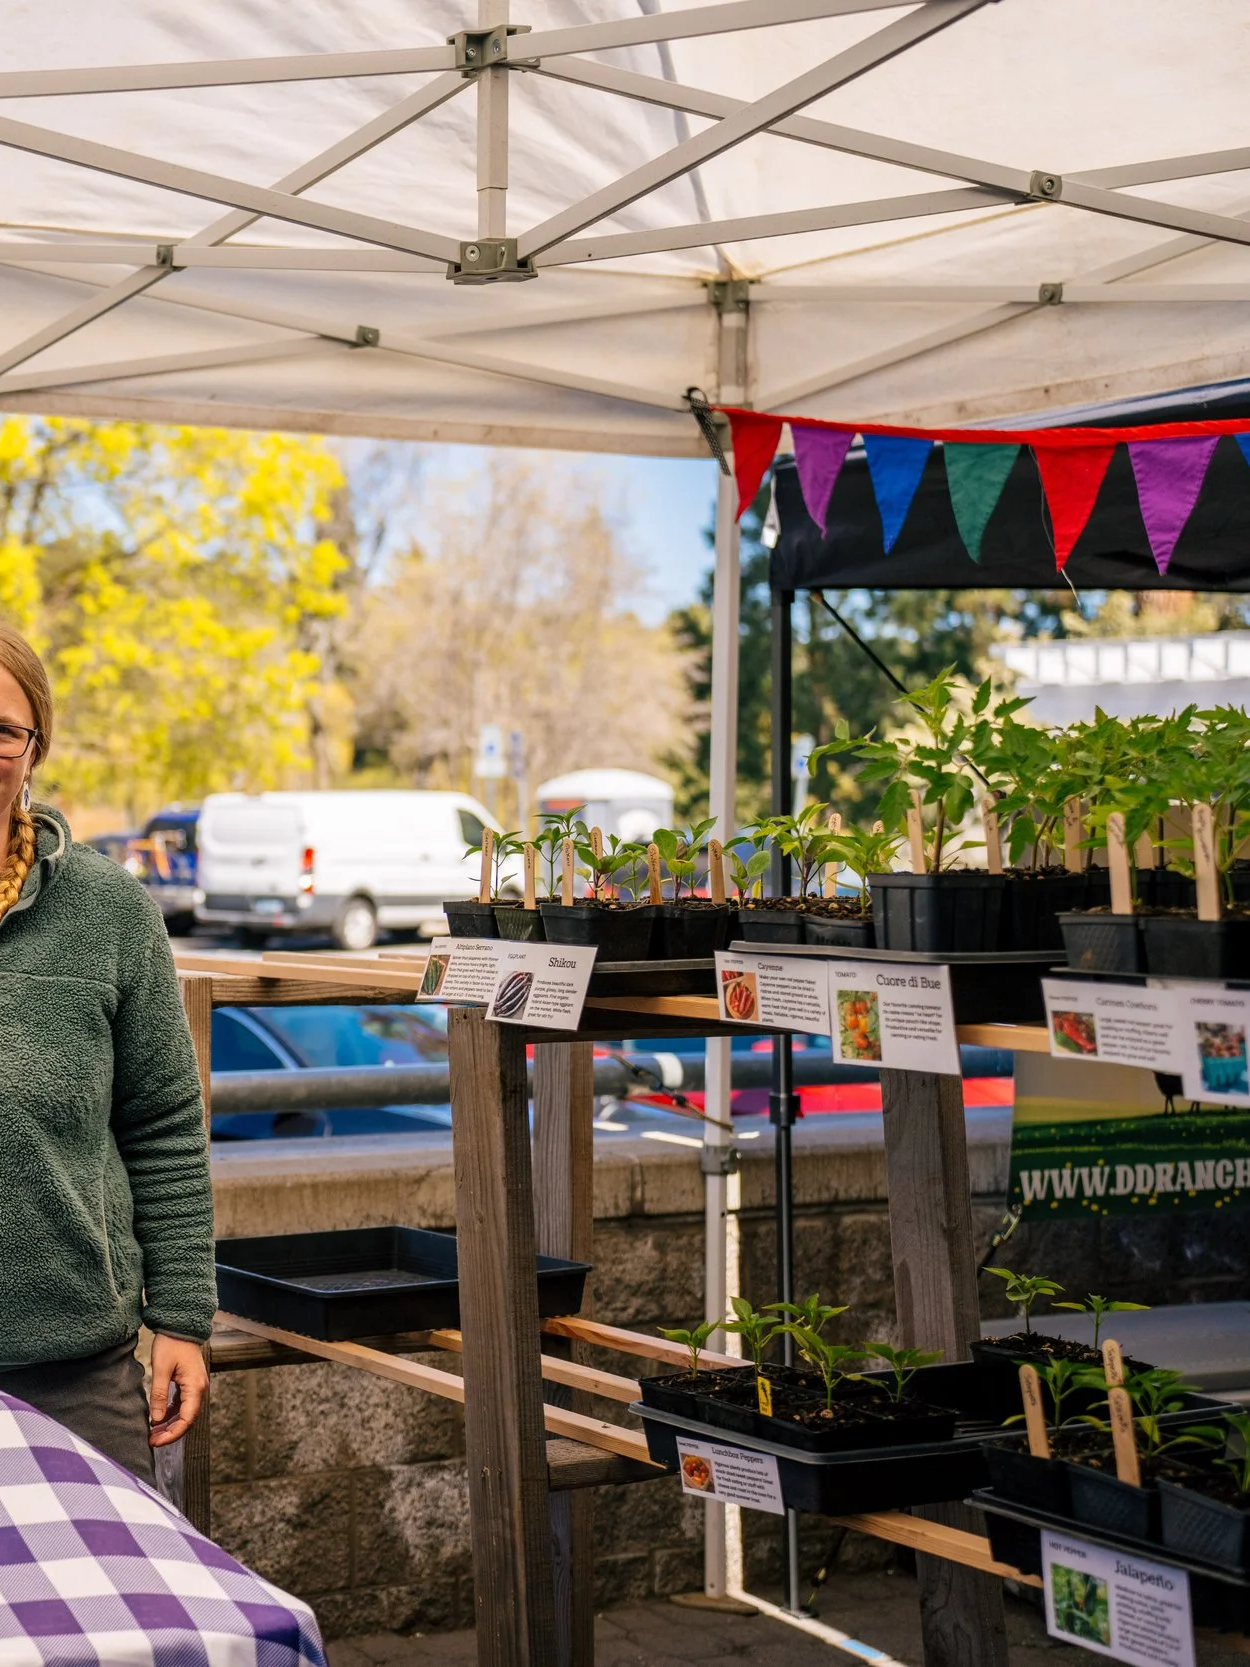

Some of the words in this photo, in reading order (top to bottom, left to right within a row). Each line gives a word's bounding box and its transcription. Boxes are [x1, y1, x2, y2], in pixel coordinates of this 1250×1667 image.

[549, 957, 577, 969] Shikou
[757, 962, 784, 973] Cayenne
[876, 974, 906, 987] Cuore
[908, 976, 918, 988] di
[920, 977, 941, 990] Bue
[1019, 1158, 1250, 1201] WWW.DDRANCH
[712, 1447, 739, 1459] Lunchbox
[740, 1453, 763, 1464] Peppers
[1114, 1560, 1174, 1591] Jalapeño
